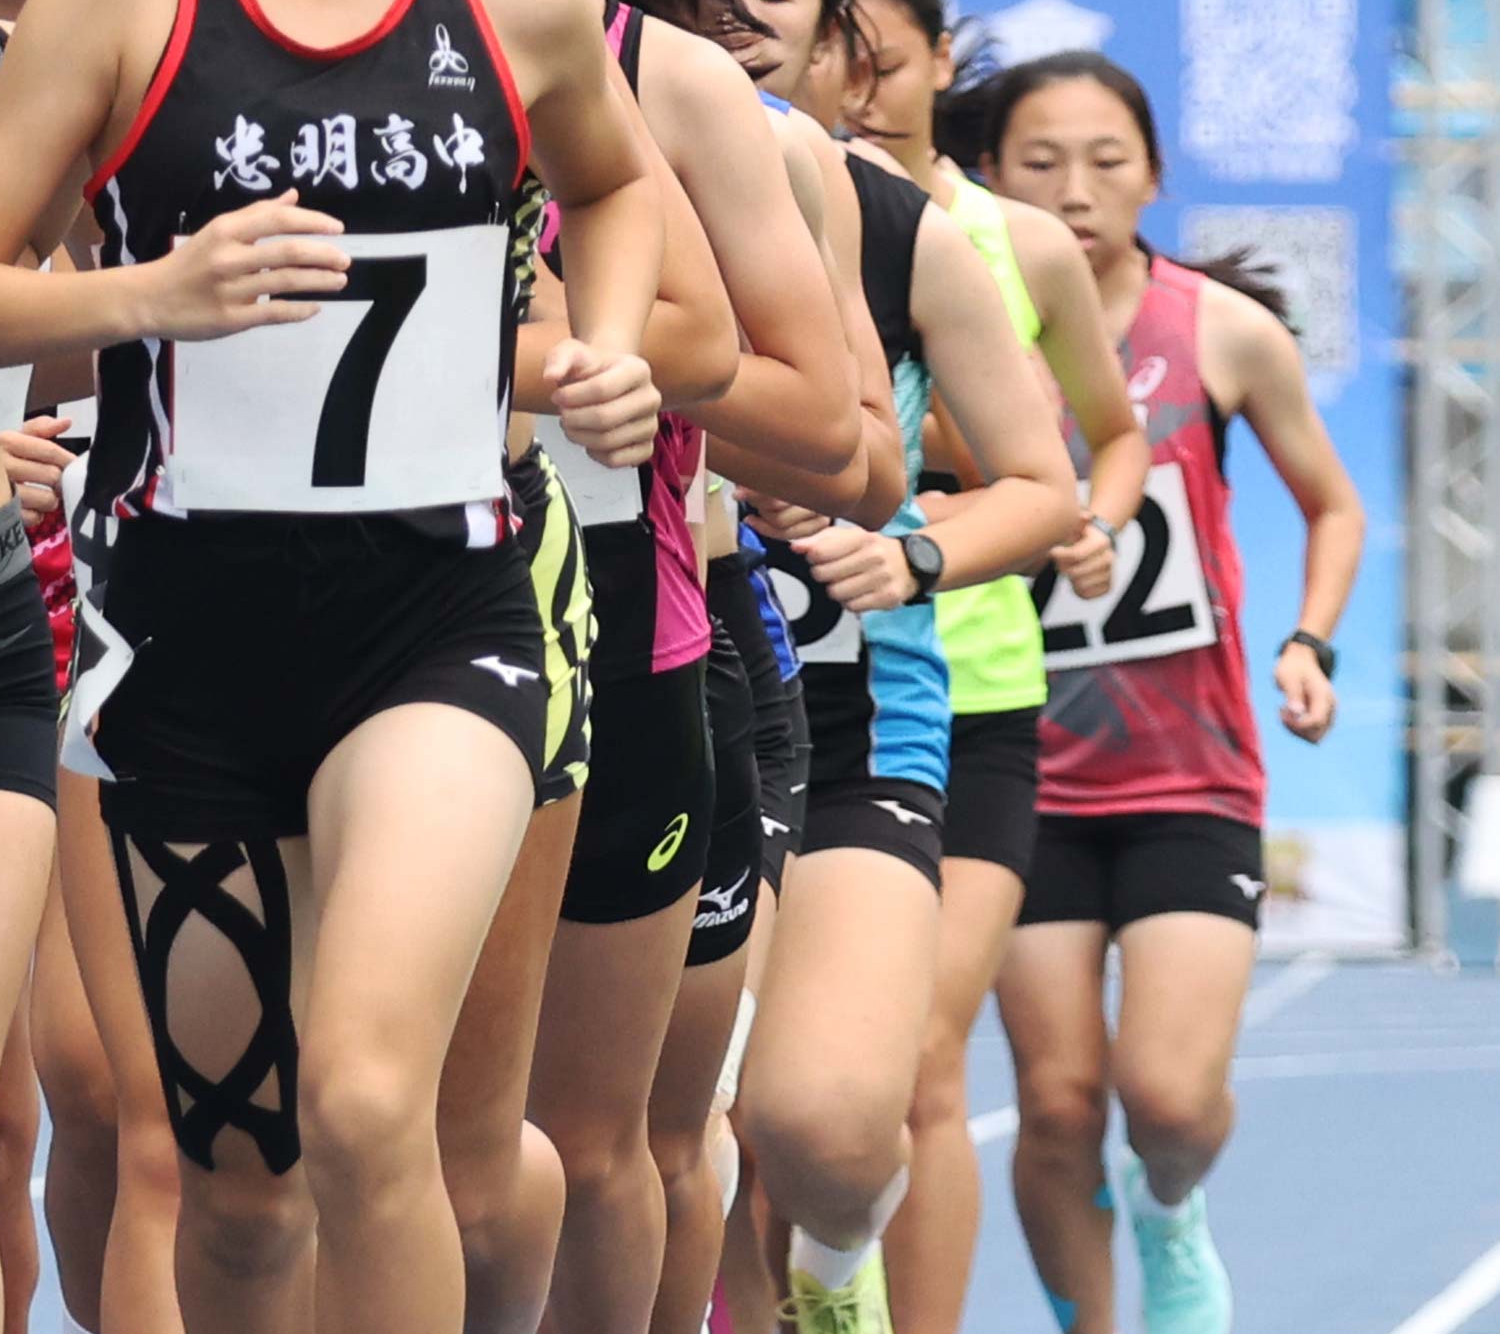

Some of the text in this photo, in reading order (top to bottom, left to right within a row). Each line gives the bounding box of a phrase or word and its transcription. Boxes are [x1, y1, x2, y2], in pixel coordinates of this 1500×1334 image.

[213, 112, 486, 194] 忠明高中
[268, 253, 428, 488] 7
